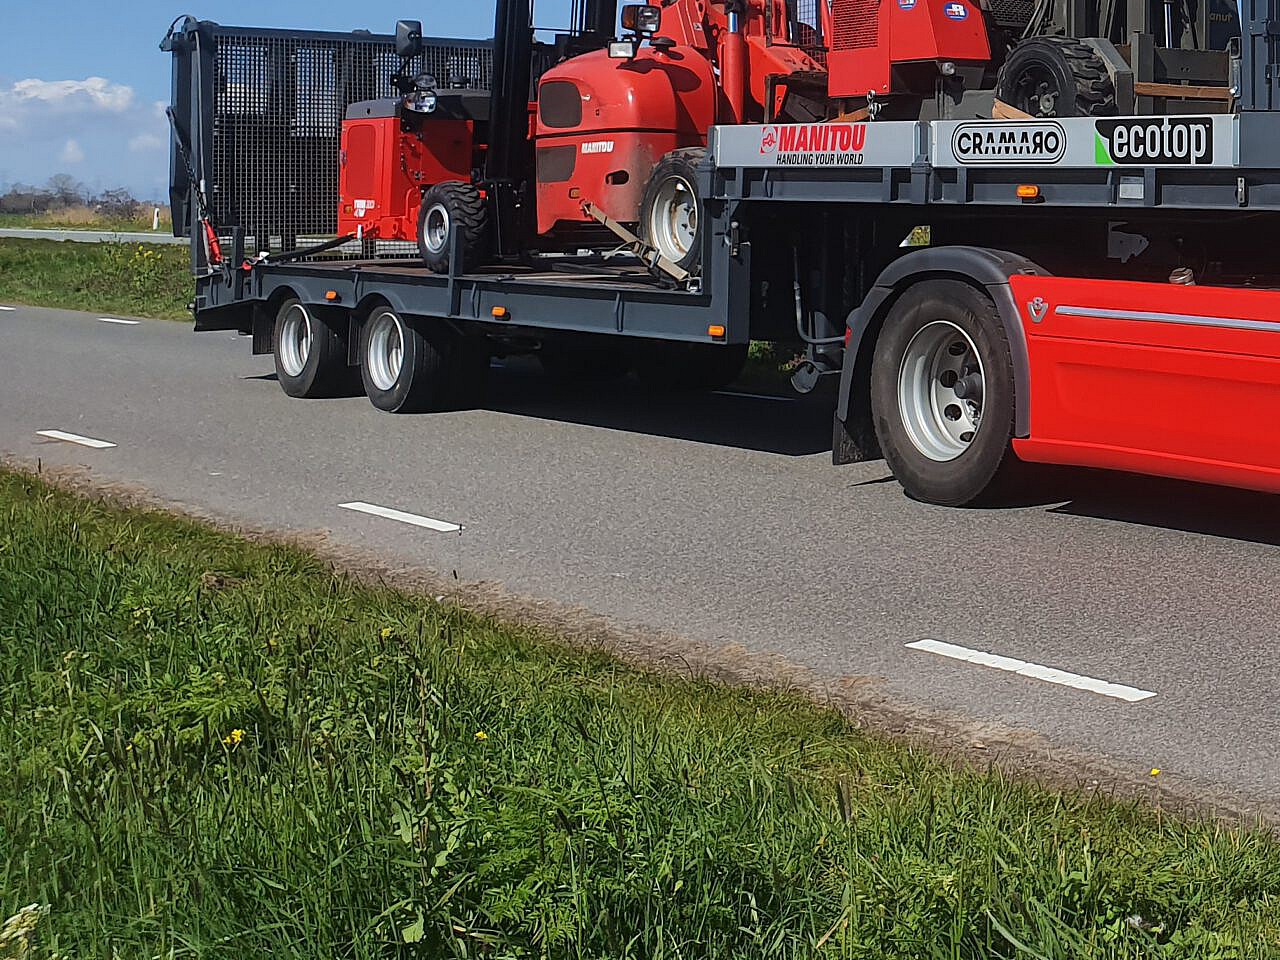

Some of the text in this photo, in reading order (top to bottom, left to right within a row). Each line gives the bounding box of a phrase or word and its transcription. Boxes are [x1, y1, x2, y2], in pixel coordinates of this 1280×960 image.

[581, 141, 615, 154] MANITOU
[778, 124, 867, 152] MANITOU
[957, 131, 1060, 155] CRAMARO
[1113, 116, 1207, 165] ecotop
[776, 153, 864, 165] HANDLING YOUR WORLD
